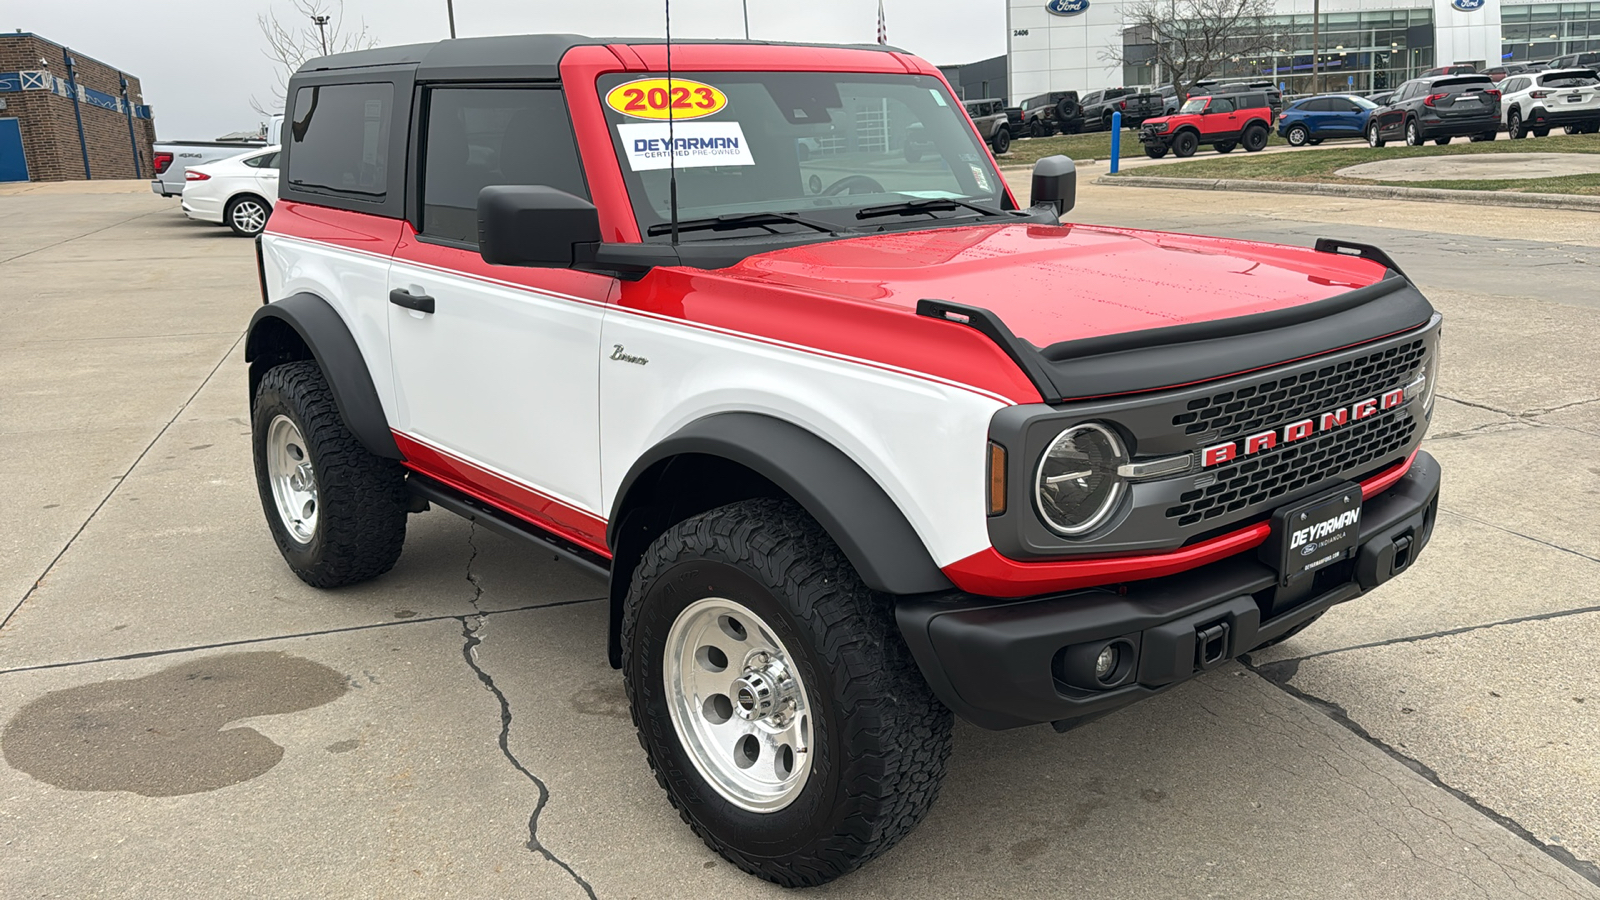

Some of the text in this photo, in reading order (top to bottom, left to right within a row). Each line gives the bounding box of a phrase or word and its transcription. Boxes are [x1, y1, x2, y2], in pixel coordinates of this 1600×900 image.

[1057, 0, 1082, 11] Ford
[623, 87, 717, 112] 2023
[634, 138, 739, 152] DEYARMAN
[609, 344, 649, 366] Bronco
[1202, 388, 1404, 468] BRONCO
[1290, 507, 1360, 550] DEYARMAN
[1319, 532, 1347, 548] INDIANOLA
